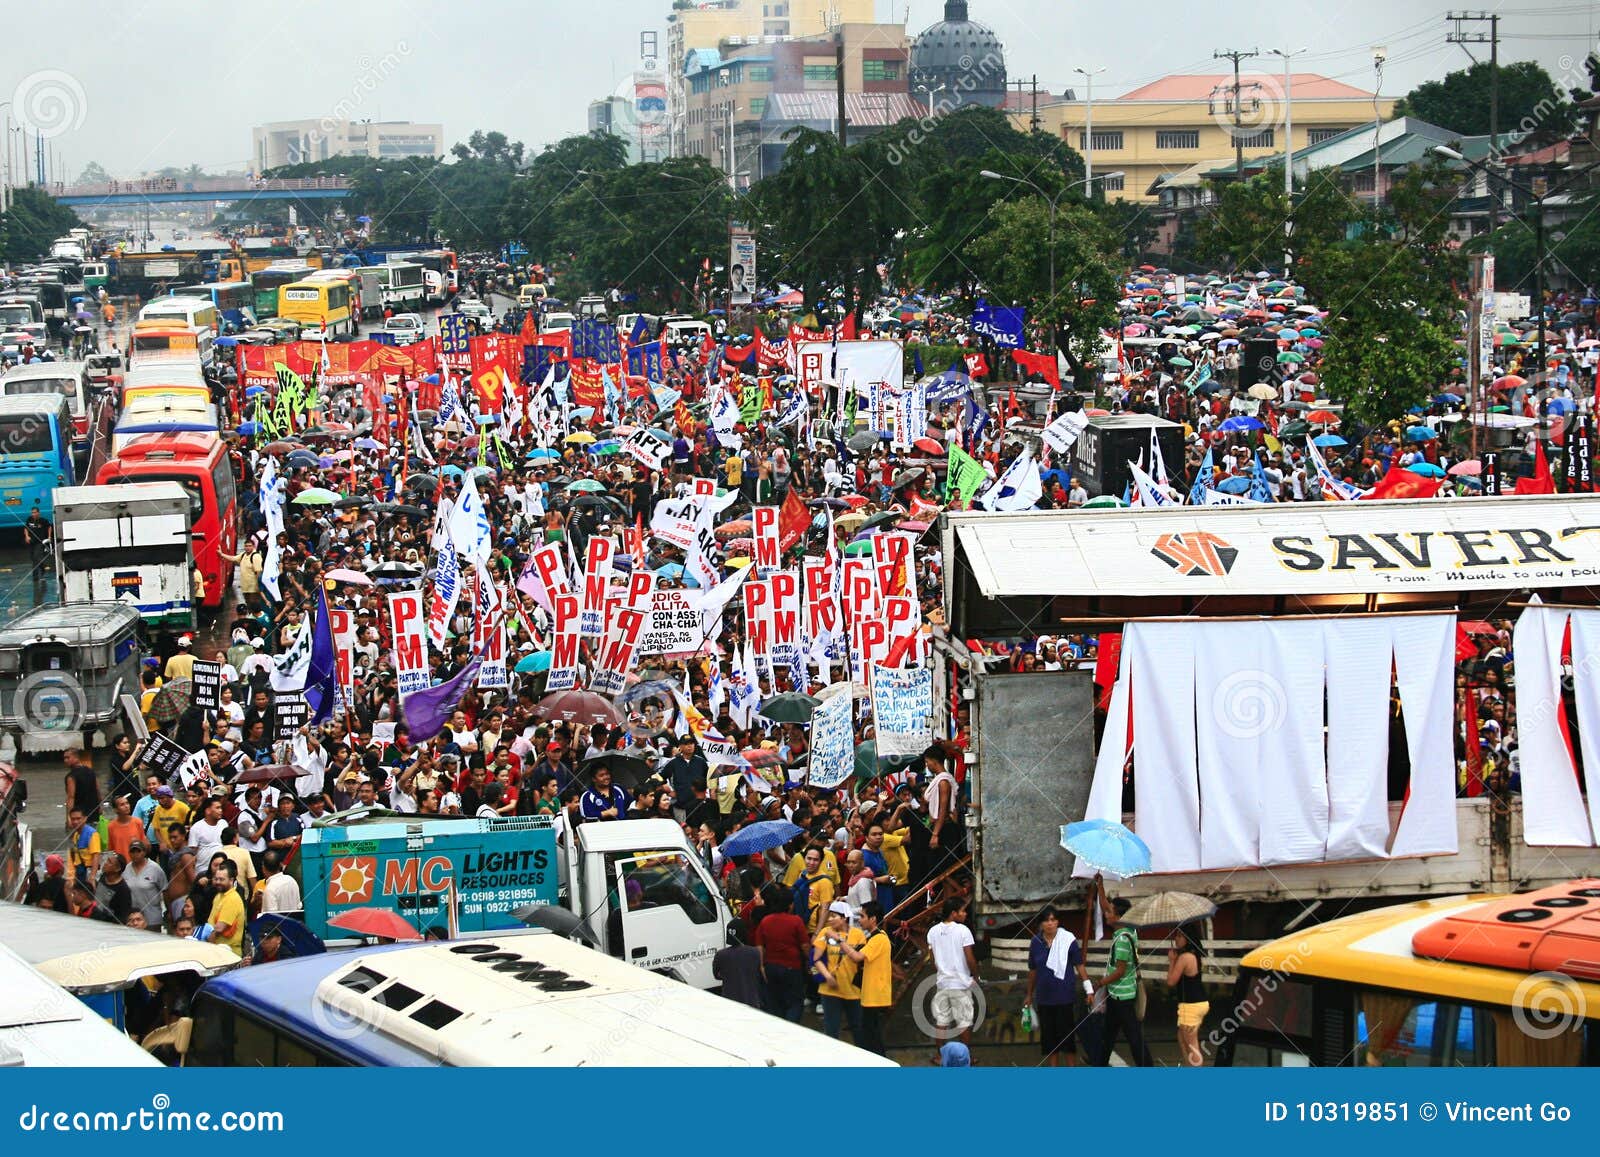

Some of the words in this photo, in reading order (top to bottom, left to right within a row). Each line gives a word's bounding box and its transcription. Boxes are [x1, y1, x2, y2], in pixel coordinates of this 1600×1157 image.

[806, 355, 819, 392] BMP
[629, 430, 663, 457] APL
[755, 508, 777, 566] PM
[584, 538, 610, 611] PM
[393, 597, 423, 671] PM
[553, 596, 578, 669] PM
[745, 583, 767, 655] PM
[771, 574, 796, 644] PM
[382, 856, 454, 896] MC
[461, 872, 545, 890] RESOURCES
[463, 849, 548, 874] LIGHTS
